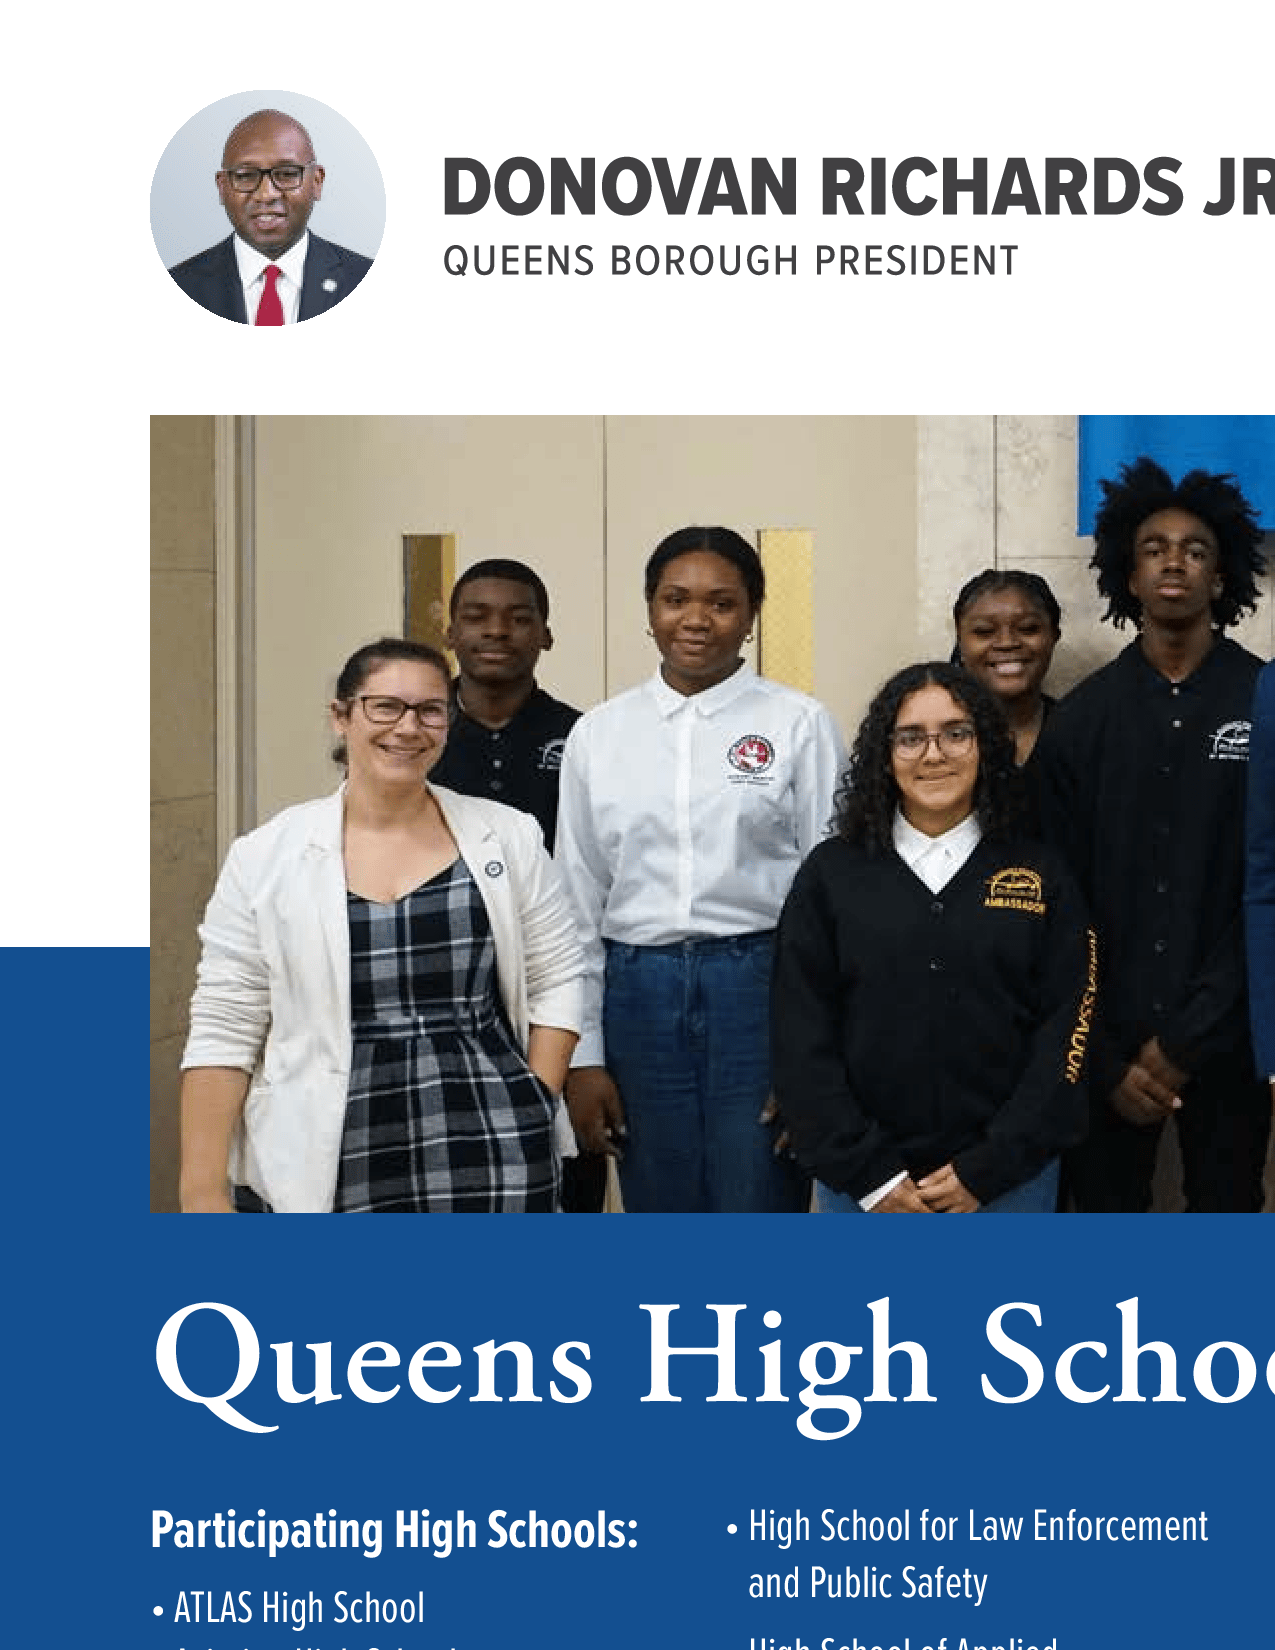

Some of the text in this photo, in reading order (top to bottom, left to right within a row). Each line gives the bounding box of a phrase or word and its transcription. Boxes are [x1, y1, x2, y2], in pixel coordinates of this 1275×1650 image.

[445, 157, 796, 216] DONOVAN
[823, 157, 1183, 216] RICHARDS
[444, 245, 1018, 276] QUEENS BOROUGH PRESIDENT
[156, 1302, 592, 1433] Queens
[639, 1297, 937, 1440] High
[153, 1509, 637, 1558] Participating High Schools:
[751, 1509, 1208, 1549] High School for Law Enforcement
[749, 1566, 988, 1606] and Public Safety
[174, 1591, 423, 1631] ATLAS High School
